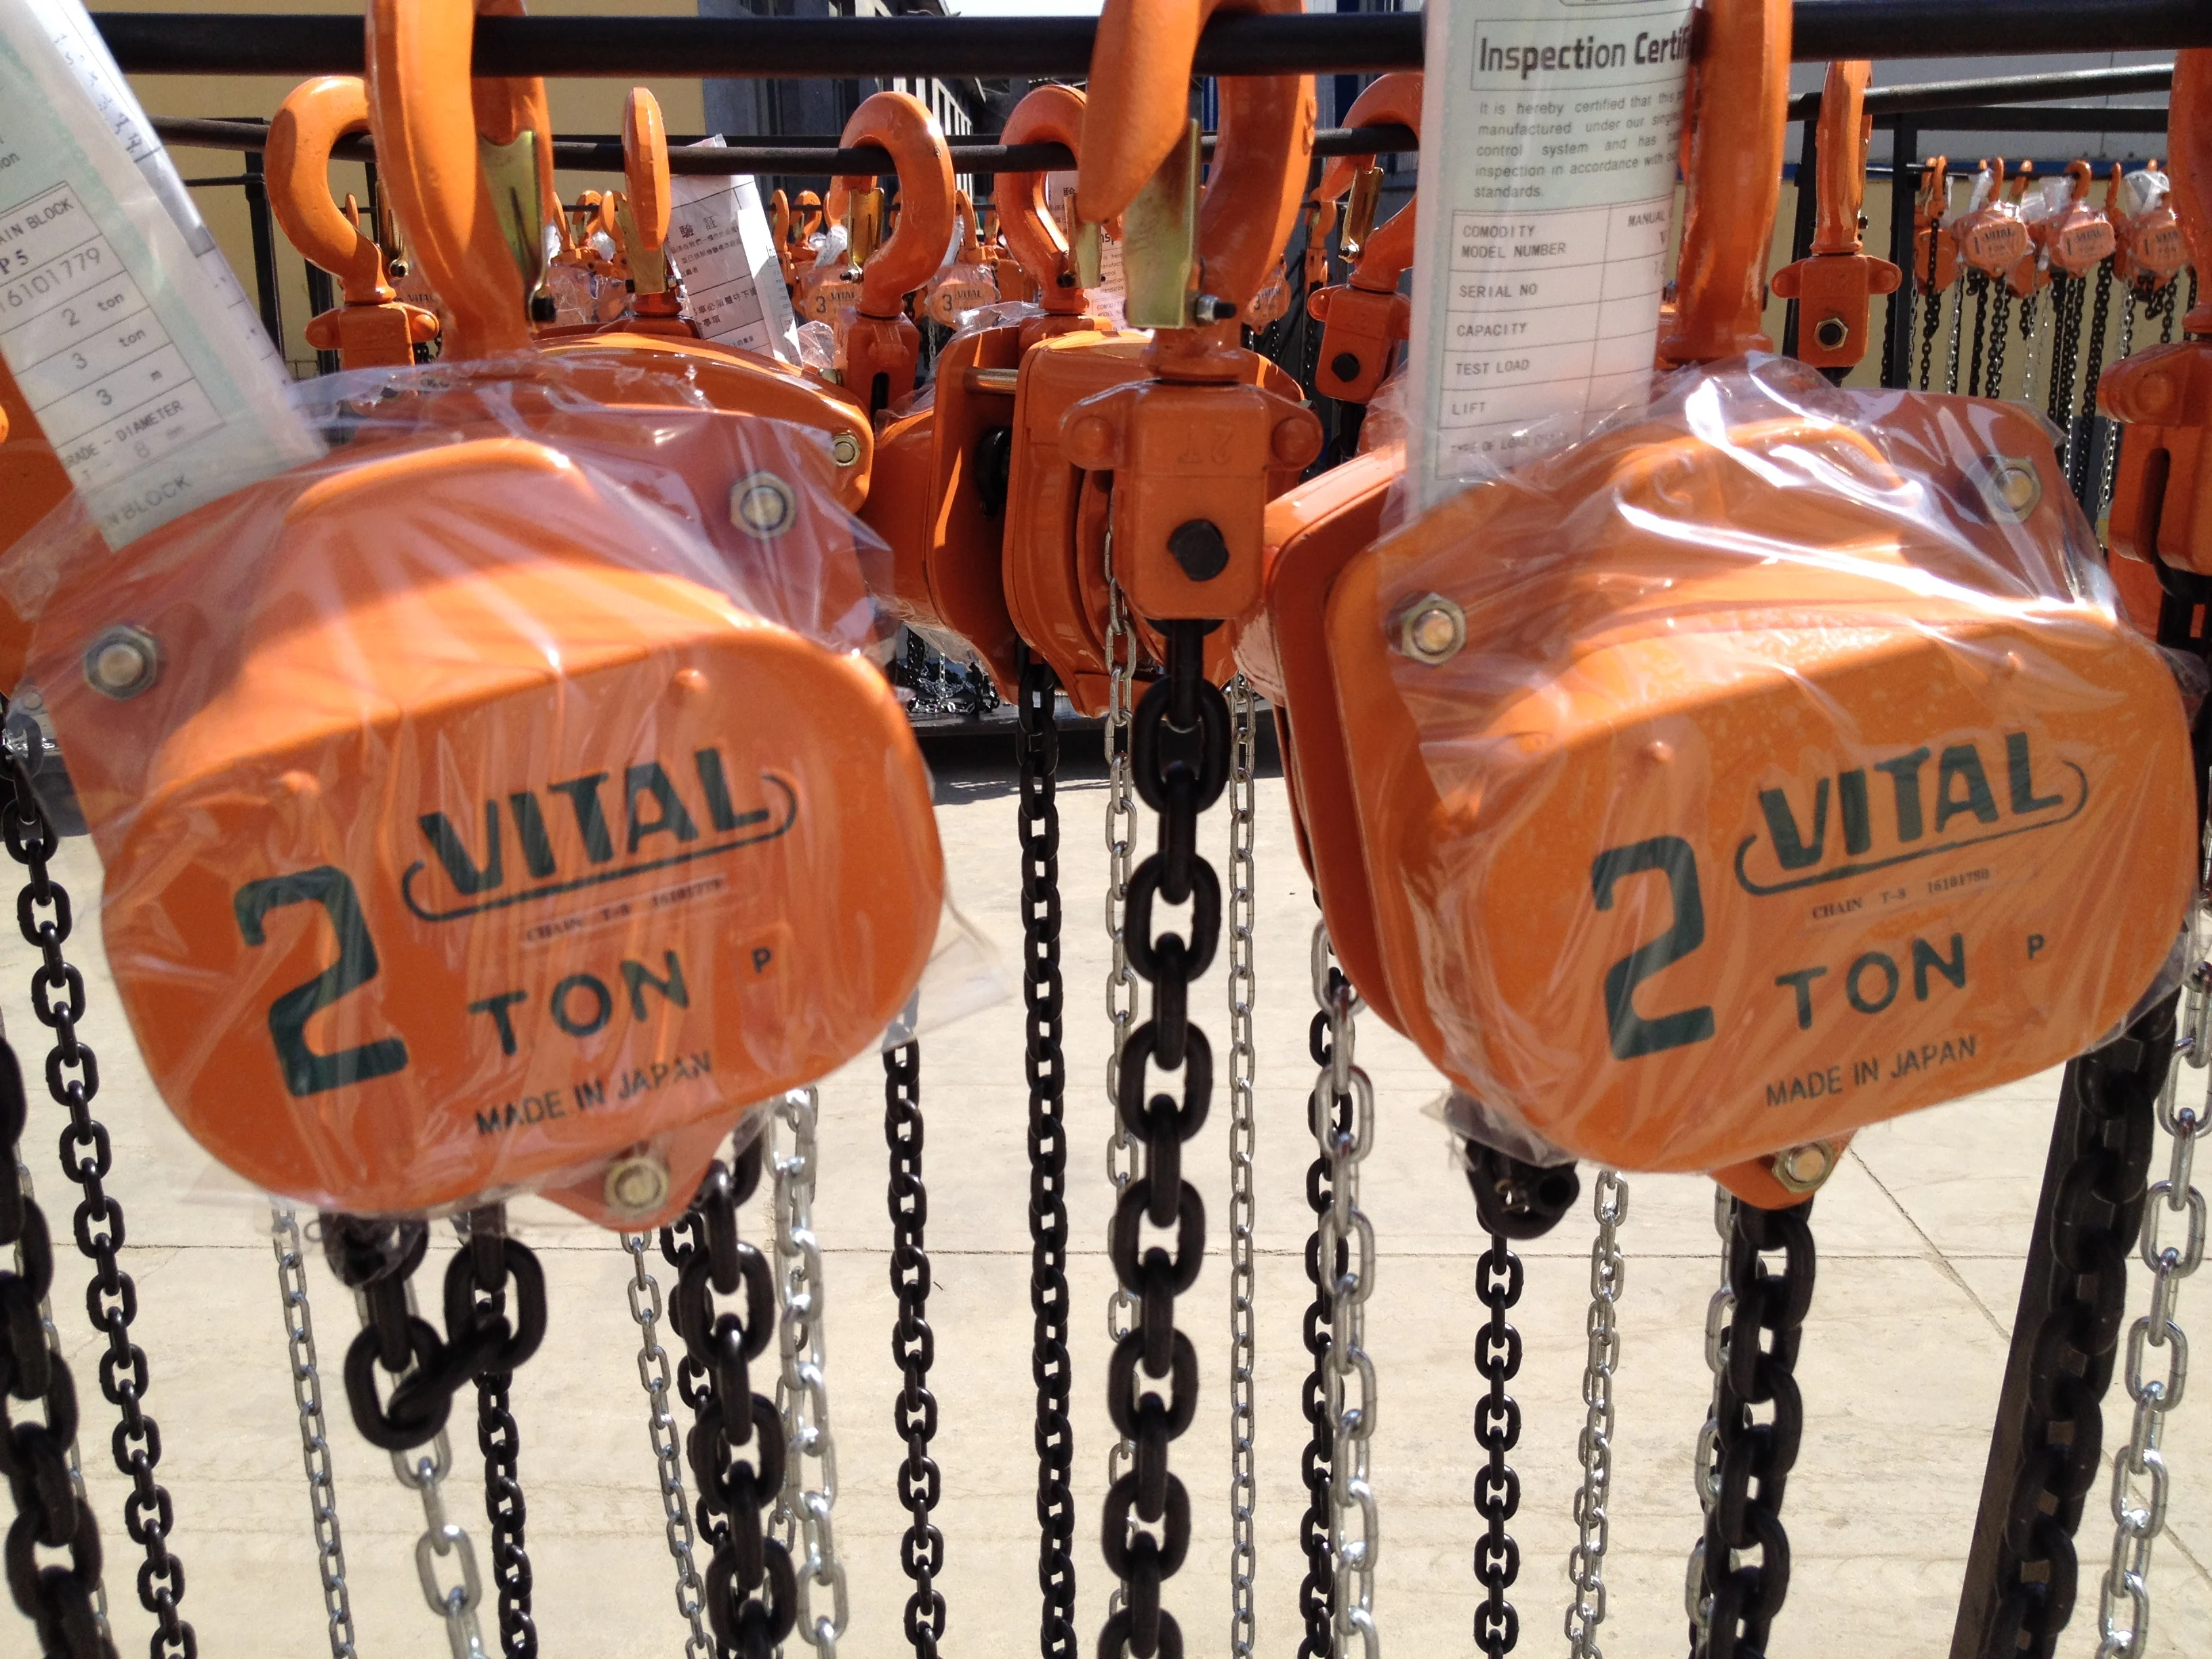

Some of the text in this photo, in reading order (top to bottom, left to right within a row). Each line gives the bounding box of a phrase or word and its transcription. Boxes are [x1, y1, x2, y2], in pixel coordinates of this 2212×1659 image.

[1478, 36, 1625, 80] Inspection
[1494, 104, 1505, 115] is
[1517, 101, 1564, 117] hereby
[1574, 97, 1625, 112] certified
[1631, 94, 1652, 108] that
[1477, 121, 1572, 136] manufactured
[1585, 119, 1620, 134] under
[1626, 117, 1645, 128] our
[1476, 144, 1522, 157] control
[1542, 142, 1589, 157] system
[1605, 138, 1626, 152] and
[1637, 135, 1656, 147] has
[1475, 164, 1545, 179] inspection
[1551, 164, 1564, 176] in
[1569, 157, 1639, 175] accordance
[1643, 152, 1663, 167] with
[26, 197, 74, 230] BLOCK
[1462, 224, 1536, 238] COMODITY
[1461, 242, 1566, 259] MODEL NUMBER
[815, 295, 826, 313] 3
[942, 293, 953, 311] 3
[1458, 283, 1538, 298] SERIAL NO
[62, 292, 125, 327] 2 ton
[1456, 323, 1528, 337] CAPACITY
[71, 329, 146, 370] 3 ton
[1455, 359, 1530, 375] TEST LOAD
[96, 388, 113, 407] 3
[1452, 402, 1486, 415] LIFT
[115, 399, 184, 442] DIAMETER
[121, 474, 192, 520] BLOCK
[1757, 732, 2063, 871] VITAL
[418, 747, 772, 896] VITAL
[1811, 897, 1864, 918] CHAIN
[1591, 835, 1715, 1061] 2
[2027, 933, 2045, 960] P
[751, 947, 772, 974] P
[233, 865, 409, 1098] 2
[1776, 932, 1967, 1031] TON
[468, 949, 691, 1057] TON
[1765, 1034, 1978, 1109] MADE IN JAPAN
[475, 1052, 714, 1136] MADE IN JAPAN
